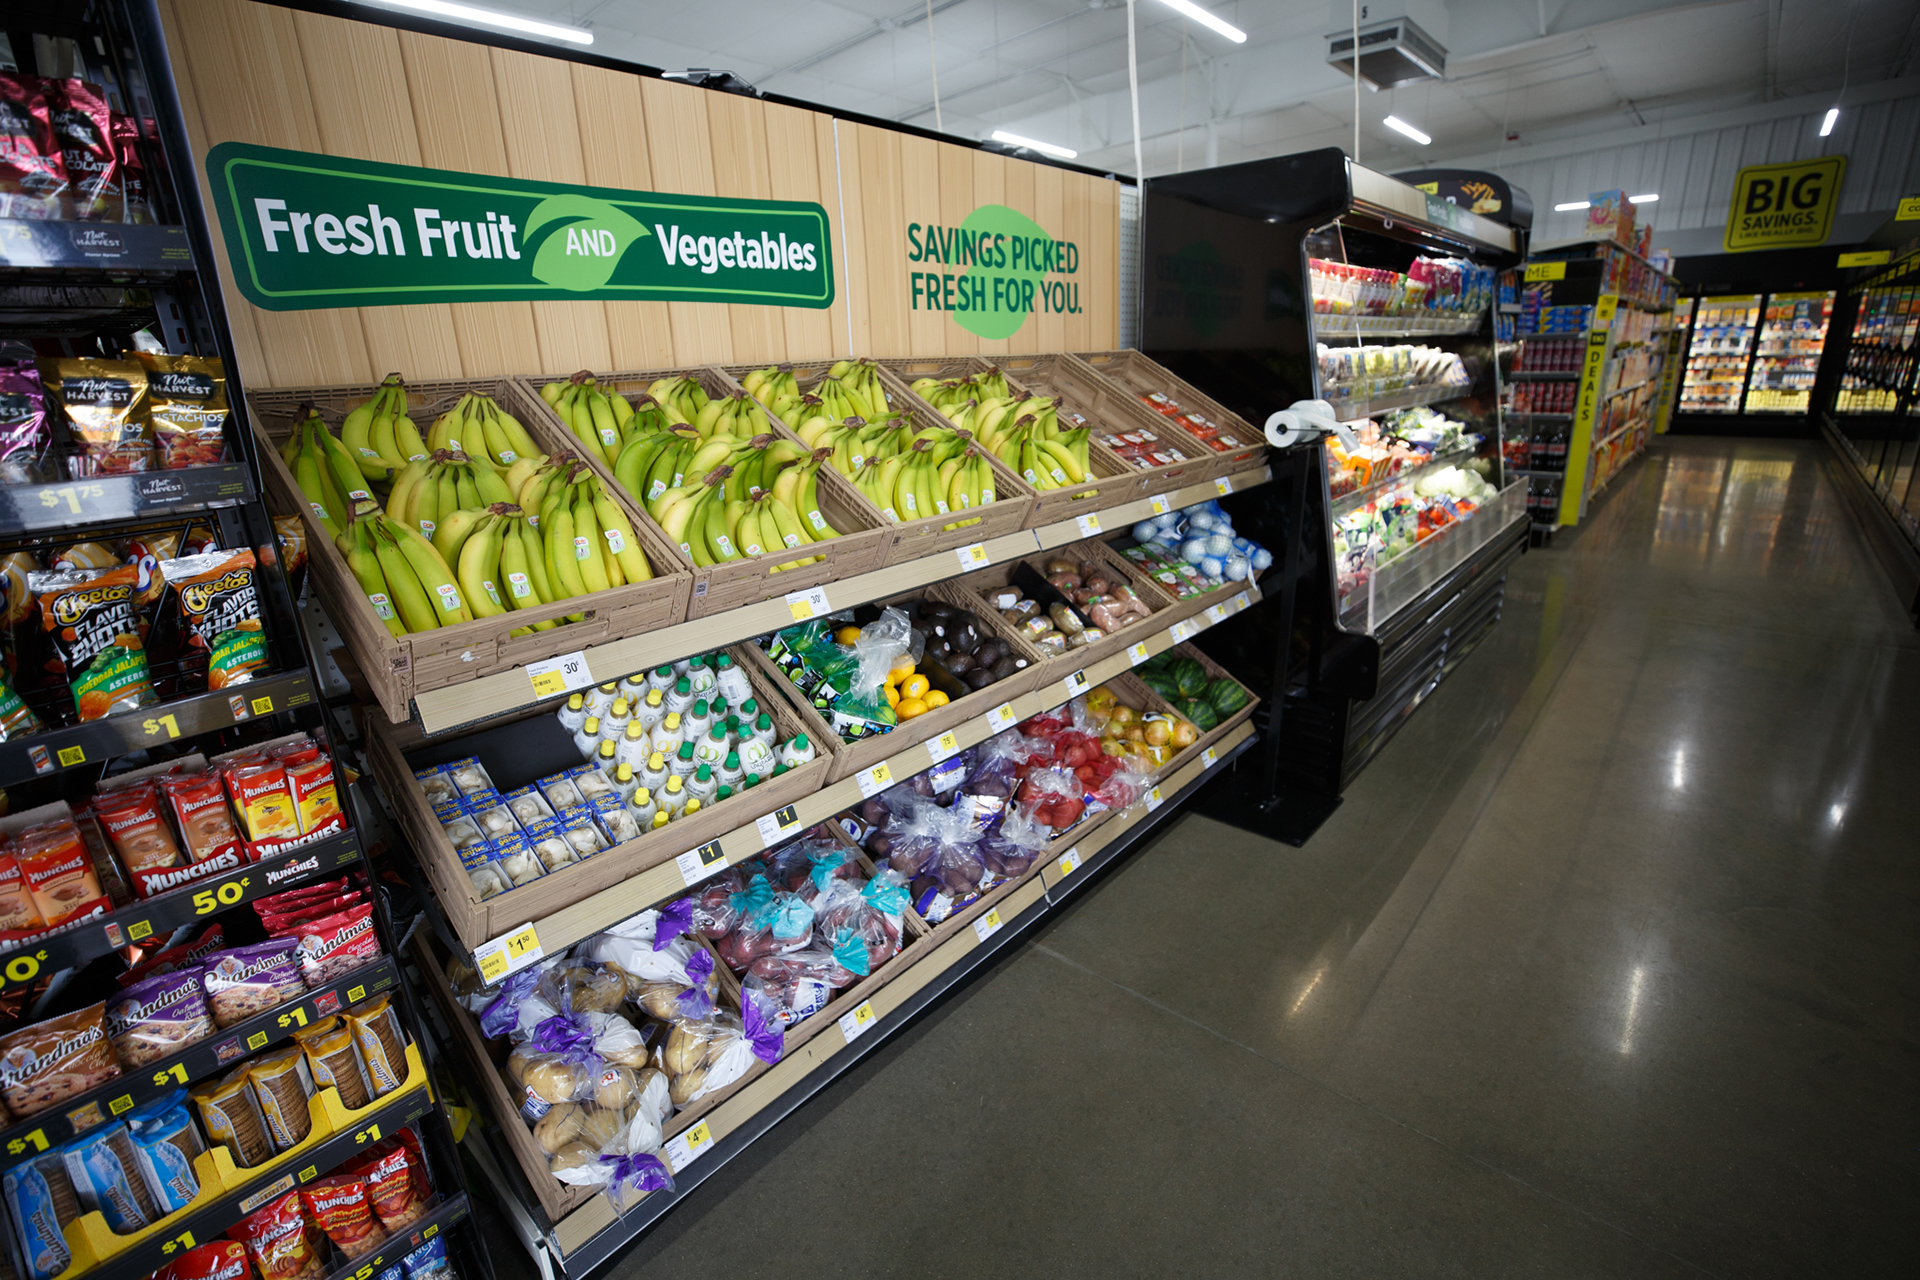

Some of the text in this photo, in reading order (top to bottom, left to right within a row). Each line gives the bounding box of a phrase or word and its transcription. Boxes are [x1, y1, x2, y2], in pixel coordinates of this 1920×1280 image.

[65, 160, 110, 174] COLATE
[1745, 172, 1824, 215] BIG
[1741, 211, 1818, 231] SAVINGS.
[76, 239, 121, 247] HARVEST
[254, 197, 817, 275] Fresh Fruit AND Vegetables
[907, 222, 1079, 274] SAVINGS PICKED
[911, 271, 1083, 314] FRESH FOR YOU.
[79, 379, 114, 392] Nut
[151, 383, 211, 395] HARVEST
[163, 374, 196, 386] Nut
[1581, 351, 1600, 421] DEALS
[66, 391, 129, 402] HARVEST
[168, 403, 205, 413] SPICY
[142, 484, 181, 495] HARVEST
[181, 568, 252, 614] Cheetos
[54, 584, 132, 626] Cheetos
[202, 586, 257, 624] FLAVOR
[74, 602, 133, 638] FLAVO
[72, 618, 139, 668] SHOTS
[77, 654, 148, 696] CHEDDAR JALAPE
[563, 660, 579, 674] 30¢
[142, 713, 181, 739] $1
[415, 767, 438, 777] garlic
[451, 757, 474, 767] garlic
[574, 764, 595, 773] garlic
[243, 778, 286, 799] MUNCHIES
[300, 771, 335, 794] MUNCHIES
[543, 773, 564, 783] garlic
[470, 790, 493, 802] garlic
[508, 786, 530, 797] garlic
[596, 795, 616, 806] garlic
[182, 792, 225, 814] MUNCHIES
[435, 802, 459, 814] garlic
[475, 798, 497, 810] garlic
[565, 807, 586, 818] garlic
[600, 803, 621, 811] garlic
[108, 808, 156, 833] MUNCHIES
[438, 809, 462, 821] garlic
[565, 816, 586, 828] garlic
[533, 820, 555, 832] garlic
[533, 830, 554, 841] garlic
[498, 834, 521, 846] garlic
[499, 843, 522, 855] garlic
[461, 845, 485, 858] garlic
[463, 854, 488, 868] garlic
[28, 856, 85, 884] MUNCHIES
[141, 846, 240, 897] MUNCHIES
[265, 855, 319, 885] MUNCHIES
[193, 876, 250, 915] 50¢
[295, 915, 374, 967] Grandma's
[204, 949, 290, 994] Grandma
[106, 975, 201, 1036] Grandma's
[277, 1006, 309, 1028] $1
[153, 1062, 190, 1086] $1
[7, 1128, 50, 1155] $1
[354, 1123, 382, 1145] $1
[104, 1186, 150, 1232] randma's
[314, 1190, 364, 1214] MUNCHIES
[161, 1230, 197, 1255] $1
[245, 1214, 305, 1255] MUNCHIES
